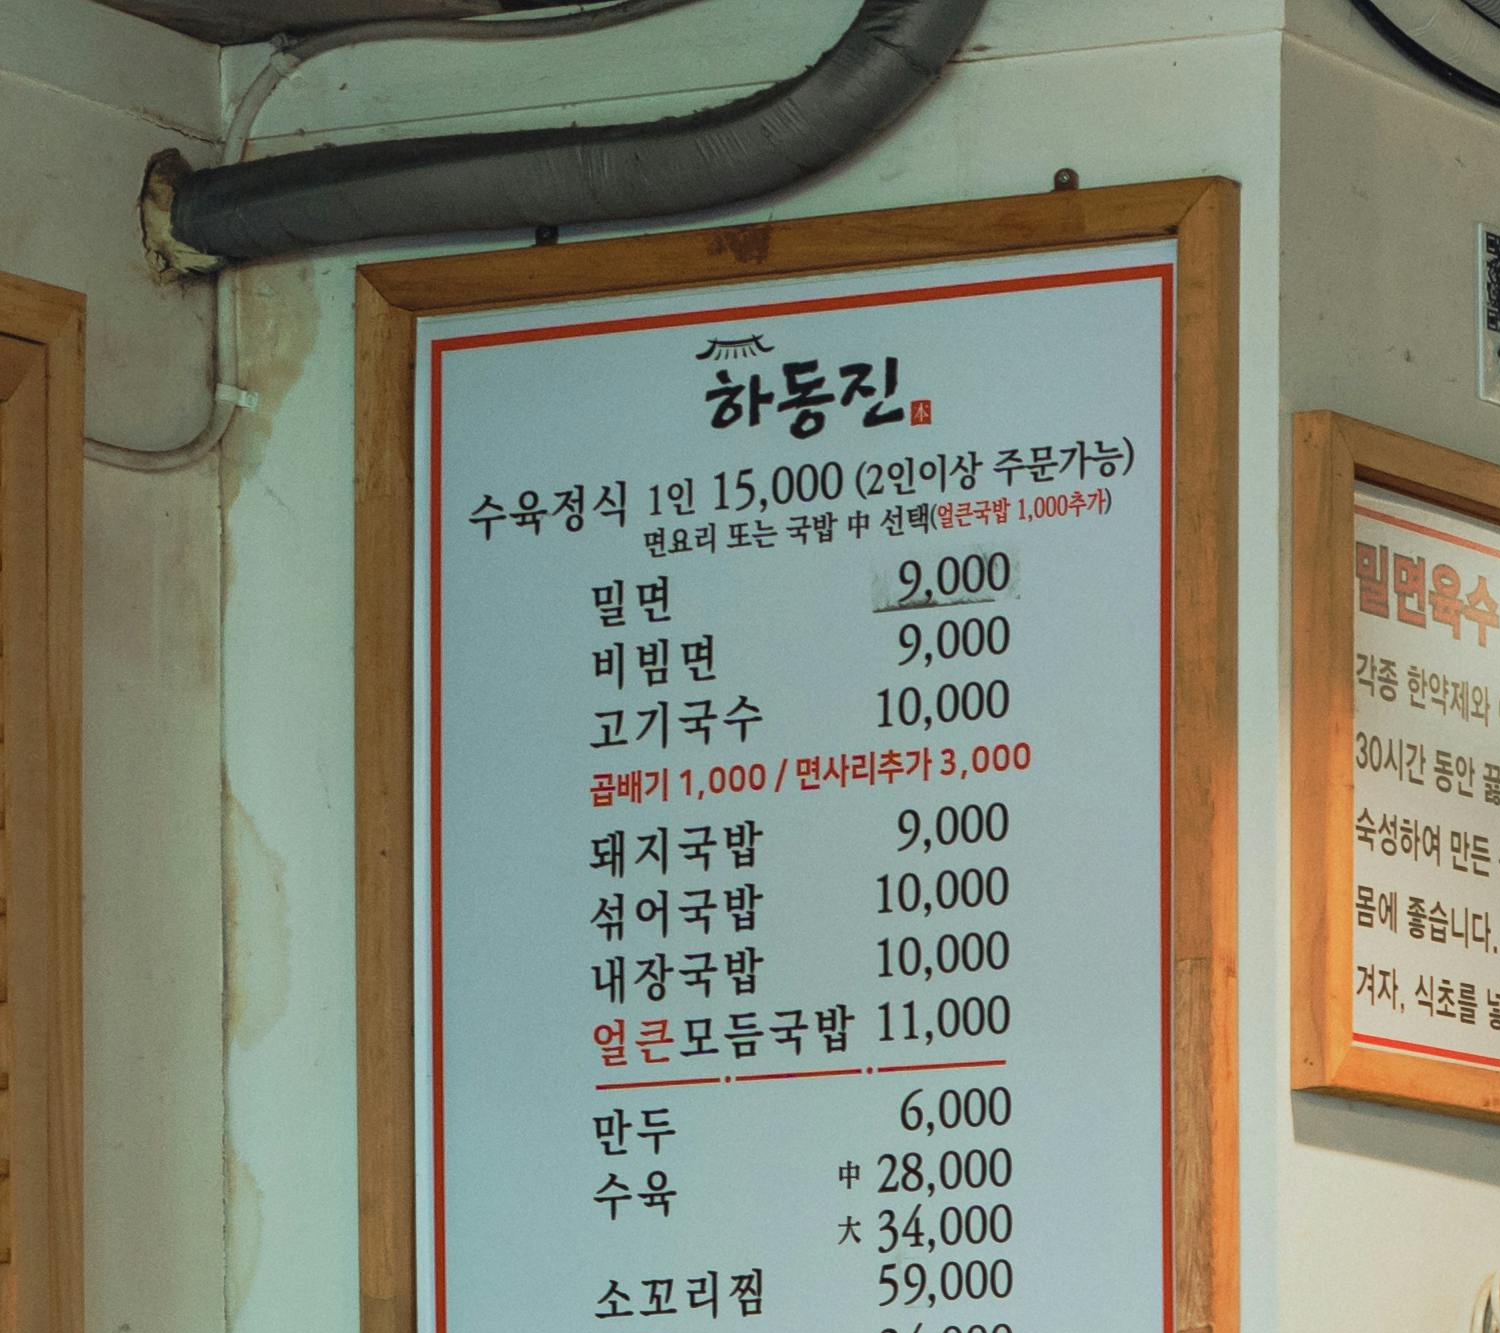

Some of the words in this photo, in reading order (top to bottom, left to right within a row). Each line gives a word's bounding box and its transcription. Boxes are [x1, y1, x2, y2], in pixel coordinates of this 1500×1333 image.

[705, 356, 906, 440] 하동진
[468, 480, 627, 541] 수육정식
[649, 478, 695, 516] 1인
[713, 461, 843, 512] 15,000
[855, 451, 983, 500] (2인이상
[992, 436, 1135, 487] 주문가능)
[643, 522, 716, 558] 면요리
[726, 520, 778, 549] 또는
[785, 511, 838, 545] 국밥
[848, 510, 870, 539] 中
[1018, 488, 1112, 521] 1,000추가)
[590, 575, 672, 628] 밀면
[897, 551, 1012, 604] 9,000
[1355, 541, 1500, 648] 밀면육수
[591, 634, 718, 691] 비빔면
[897, 616, 1012, 667] 9,000
[1356, 652, 1399, 702] 각종
[1407, 665, 1490, 728] 한약제와
[589, 694, 764, 753] 고기국수
[876, 680, 1011, 731] 10,000
[589, 767, 669, 807] 곱배기
[679, 763, 767, 800] 1,000
[774, 758, 789, 793] /
[796, 747, 932, 791] 면사리추가
[939, 742, 1032, 780] 3,000
[1355, 731, 1426, 786] 30시간
[1433, 750, 1476, 798] 동안
[589, 820, 764, 878] 돼지국밥
[896, 802, 1010, 854] 9,000
[1355, 807, 1441, 867] 숙성하여
[1450, 830, 1491, 877] 만든
[590, 883, 764, 942] 섞어국밥
[876, 866, 1010, 917] 10,000
[1355, 885, 1398, 933] 몸에
[1406, 896, 1498, 954] 좋습니다.
[590, 946, 764, 1005] 내장국밥
[877, 930, 1011, 982] 10,000
[1356, 964, 1406, 1014] 겨자,
[1414, 974, 1478, 1025] 식초를
[878, 995, 1012, 1045] 11,000
[592, 1107, 678, 1157] 만두
[900, 1087, 1014, 1136] 6,000
[594, 1168, 679, 1221] 수육
[838, 1160, 861, 1192] 中
[877, 1148, 1014, 1197] 28,000
[838, 1216, 862, 1247] 大
[877, 1203, 1015, 1255] 34,000
[594, 1267, 765, 1321] 소꼬리찜
[878, 1258, 1015, 1308] 59,000
